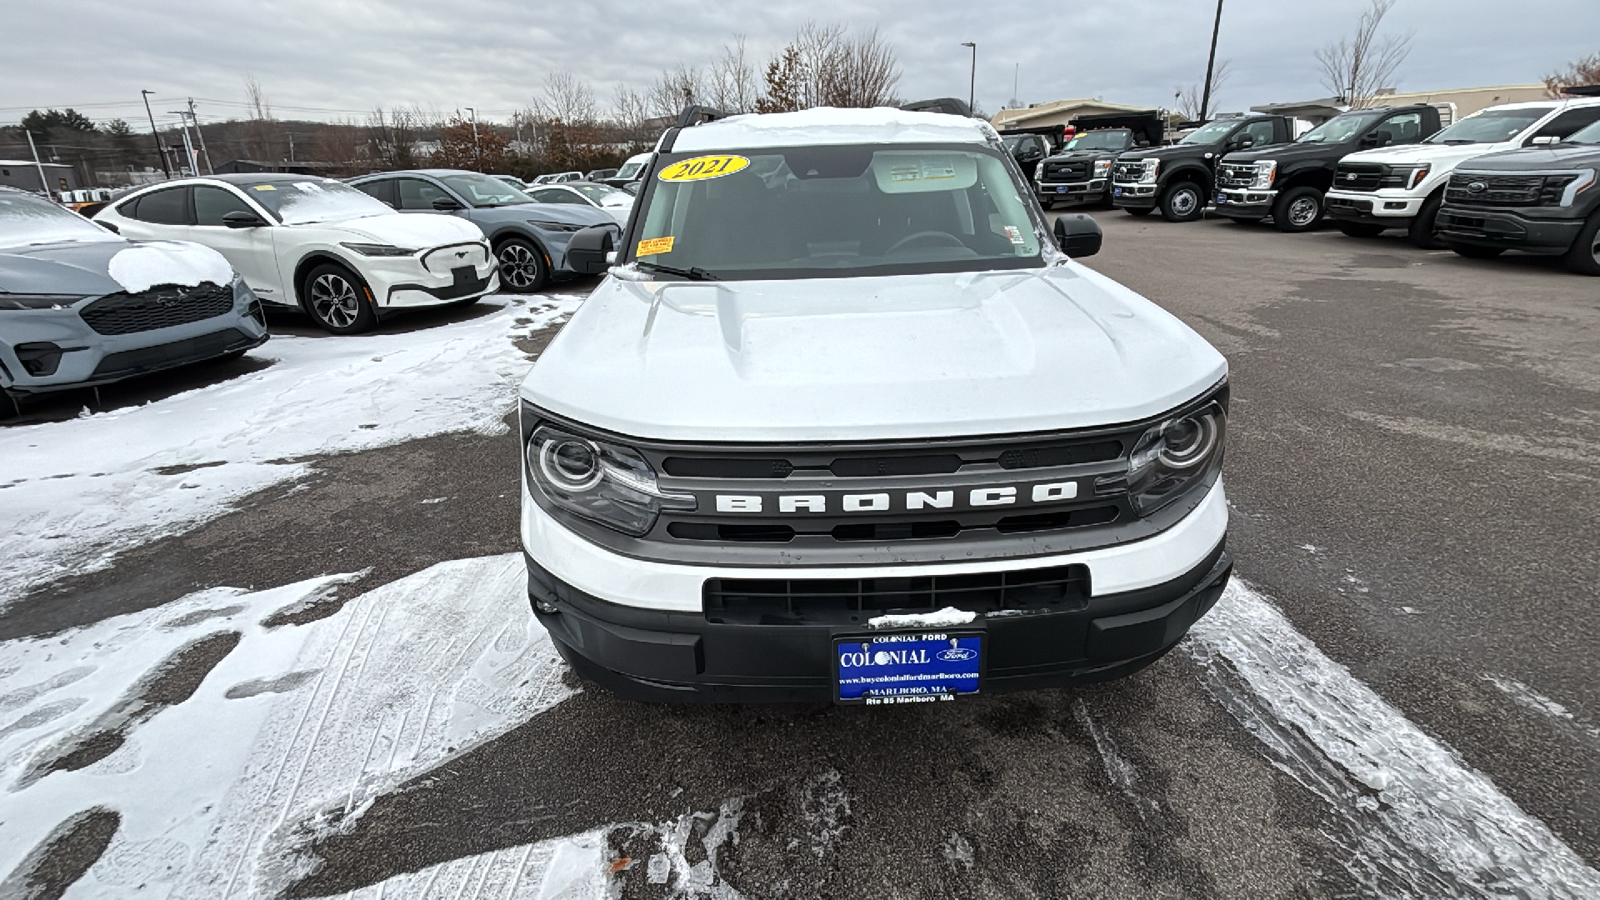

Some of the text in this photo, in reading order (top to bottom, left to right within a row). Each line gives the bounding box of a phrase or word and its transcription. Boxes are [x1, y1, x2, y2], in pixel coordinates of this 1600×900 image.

[672, 157, 733, 179] 2021
[715, 481, 1078, 513] BRONCO
[872, 635, 918, 644] COLONIAL
[840, 649, 930, 668] COLONIAL
[942, 649, 971, 660] Ford
[839, 672, 979, 685] www.buycolonialfordmarlboro.com
[866, 698, 881, 706] Rte
[897, 696, 936, 704] Marlboro
[940, 694, 954, 702] MA
